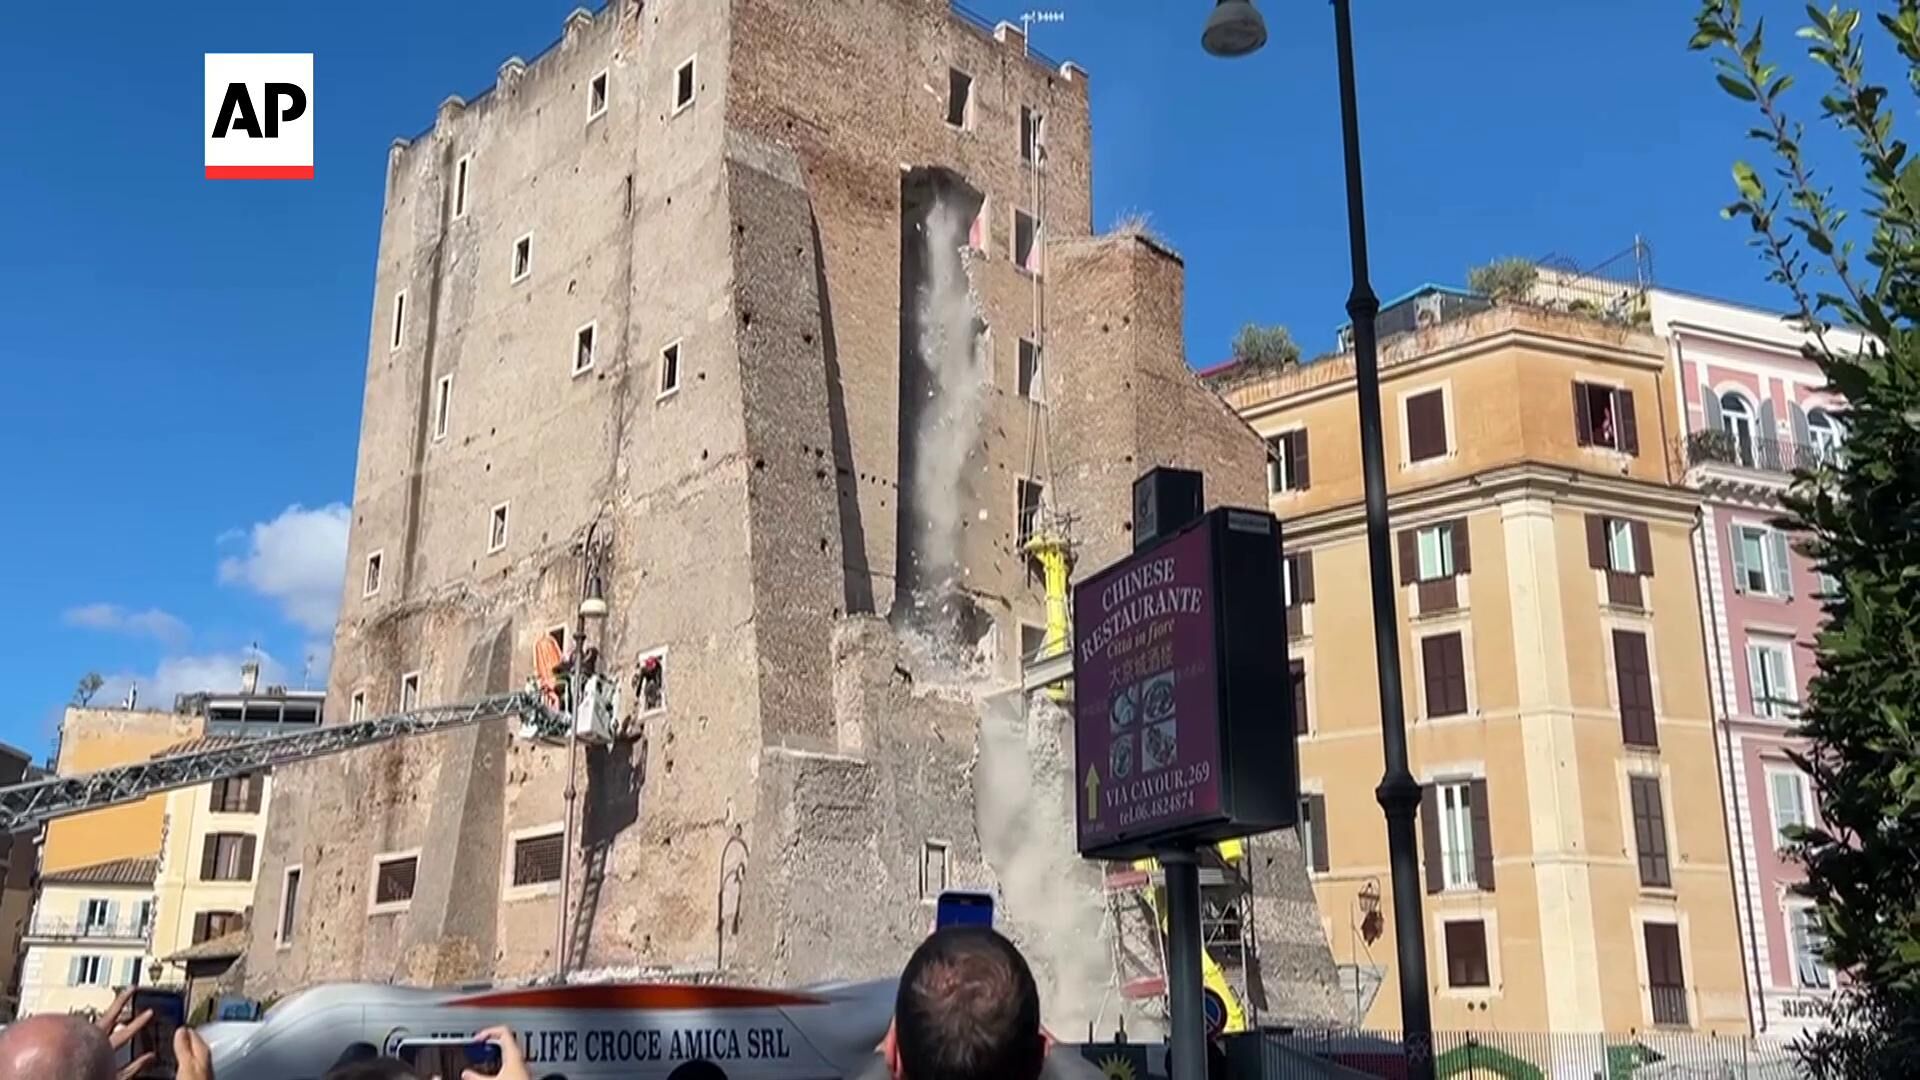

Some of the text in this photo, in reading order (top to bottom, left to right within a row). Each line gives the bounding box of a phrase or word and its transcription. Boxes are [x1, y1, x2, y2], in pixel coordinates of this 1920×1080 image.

[1102, 558, 1176, 612] CHINESE
[1081, 587, 1203, 664] RESTAURANTE
[1106, 785, 1128, 808] VIA
[524, 1027, 790, 1062] LIFE CROCE AMICA SRL
